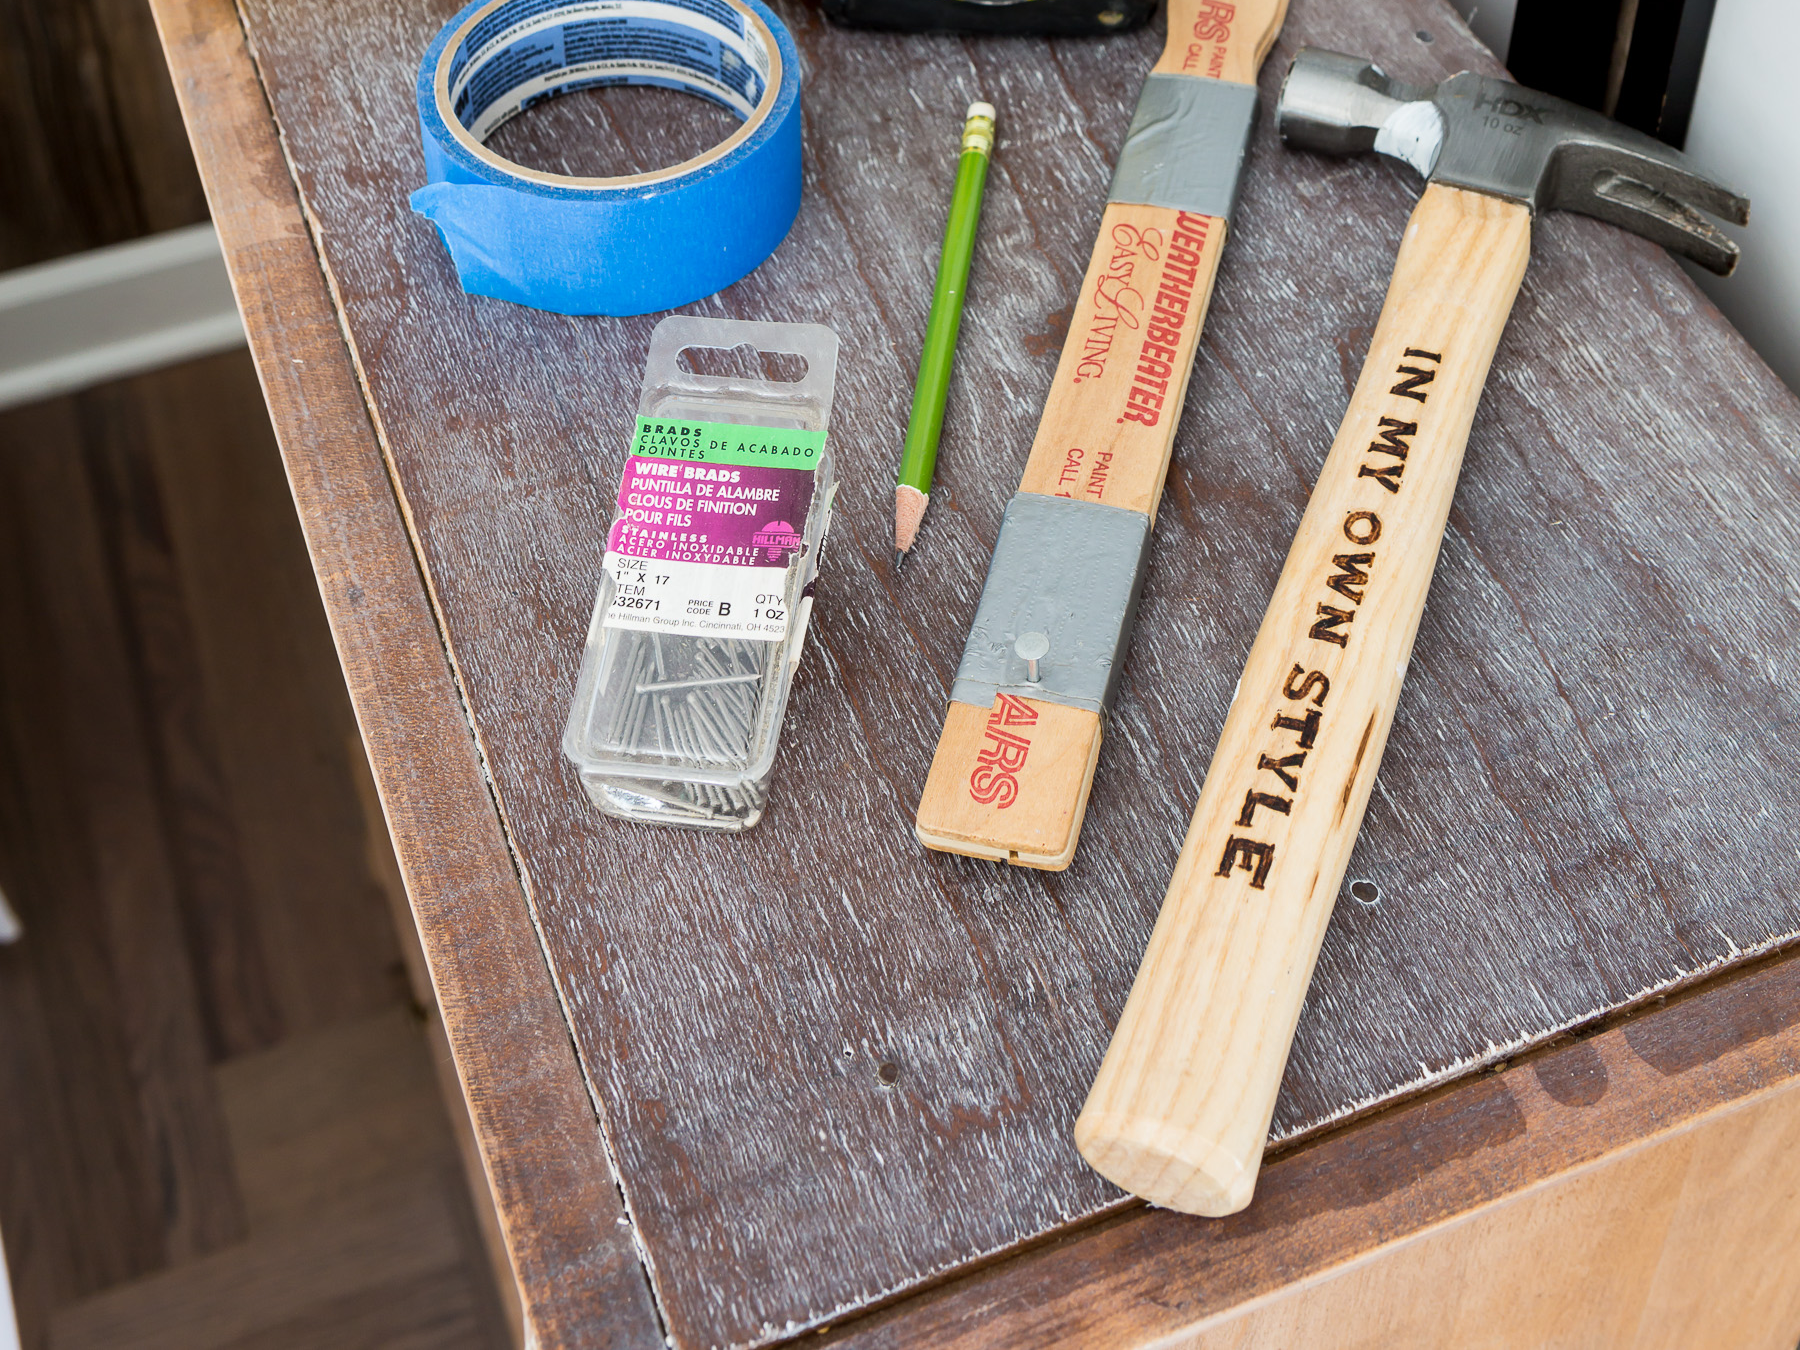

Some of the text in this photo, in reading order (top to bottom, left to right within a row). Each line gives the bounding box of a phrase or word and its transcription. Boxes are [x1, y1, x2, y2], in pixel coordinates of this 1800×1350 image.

[1206, 45, 1227, 79] PAINT
[1473, 92, 1548, 125] HDX
[1482, 115, 1500, 129] 10
[643, 424, 702, 437] BRADS
[638, 445, 705, 459] POINTES
[640, 434, 815, 458] CLAVOS DE ACABADO
[635, 461, 741, 483] WIRE BRADS
[1058, 448, 1085, 485] CALL
[1086, 451, 1113, 499] PAINT
[630, 477, 780, 502] PUNTILLA DE ALAMBRE
[627, 492, 758, 516] CLOUS DE FINITION
[624, 508, 692, 527] POUR FILS
[621, 525, 708, 543] STAINLESS
[752, 534, 800, 546] HILLMAN
[617, 544, 756, 566] ACIER INOXYDABLE
[619, 534, 760, 557] ACERO INOXIDABLE
[617, 557, 648, 571] SIZE
[655, 575, 670, 585] 17
[687, 599, 714, 608] PRICE
[718, 601, 731, 616] B
[755, 594, 783, 606] QTY
[686, 607, 711, 615] CODE
[753, 608, 785, 620] 1 OZ
[1213, 346, 1442, 891] IN MY OWN STYLE
[618, 612, 650, 623] Hillman
[652, 616, 680, 627] Group
[681, 619, 696, 627] Inc.
[699, 620, 743, 631] Cincinnati,
[746, 622, 761, 631] OH
